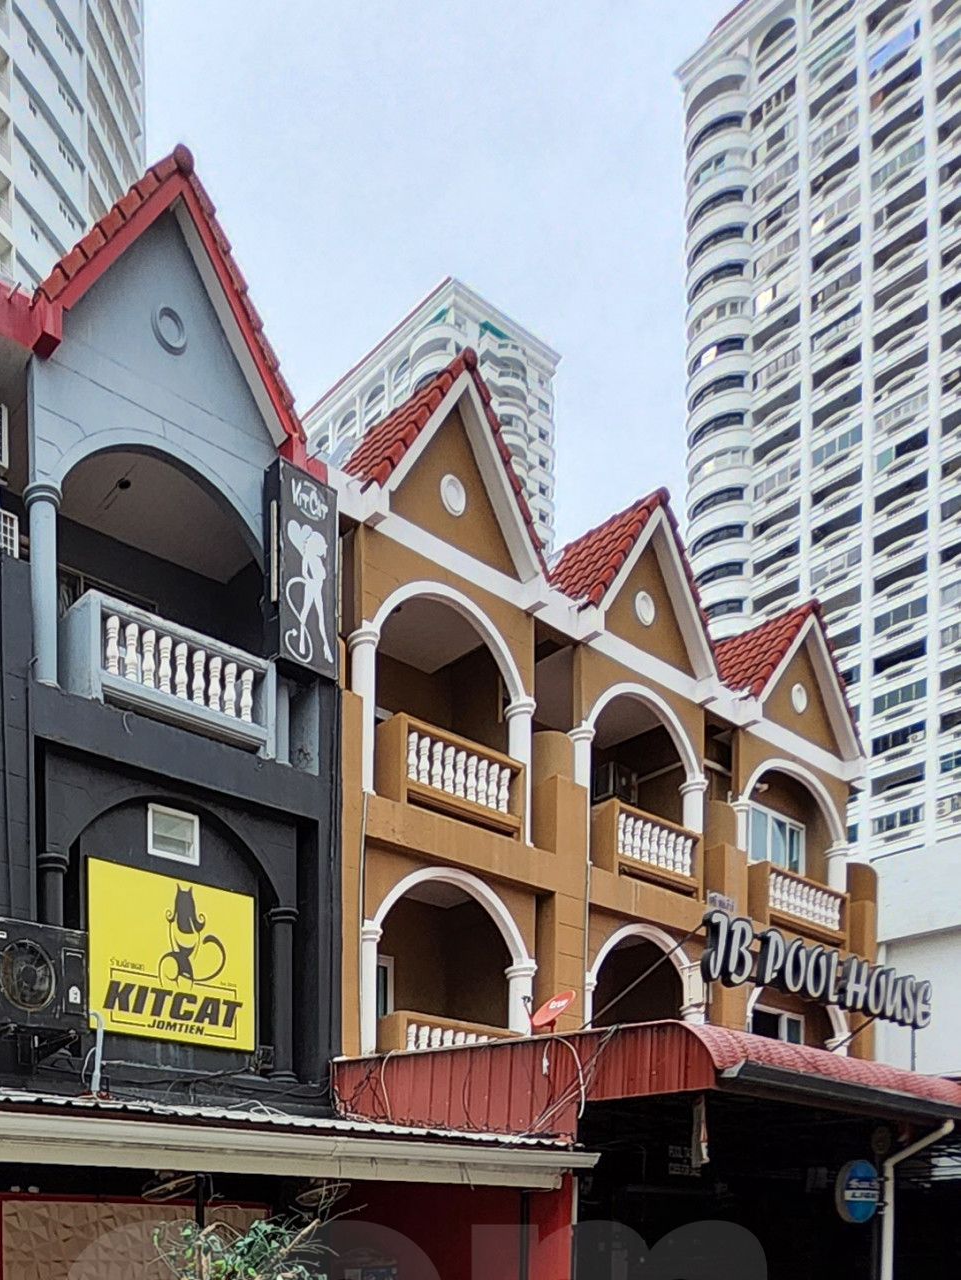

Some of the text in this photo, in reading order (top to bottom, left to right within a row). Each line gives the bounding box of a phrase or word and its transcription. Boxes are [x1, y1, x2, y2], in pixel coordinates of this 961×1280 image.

[707, 911, 932, 1029] JB POOL HOUSE
[103, 980, 244, 1028] KITCAT
[147, 1019, 206, 1036] JOMTIEN
